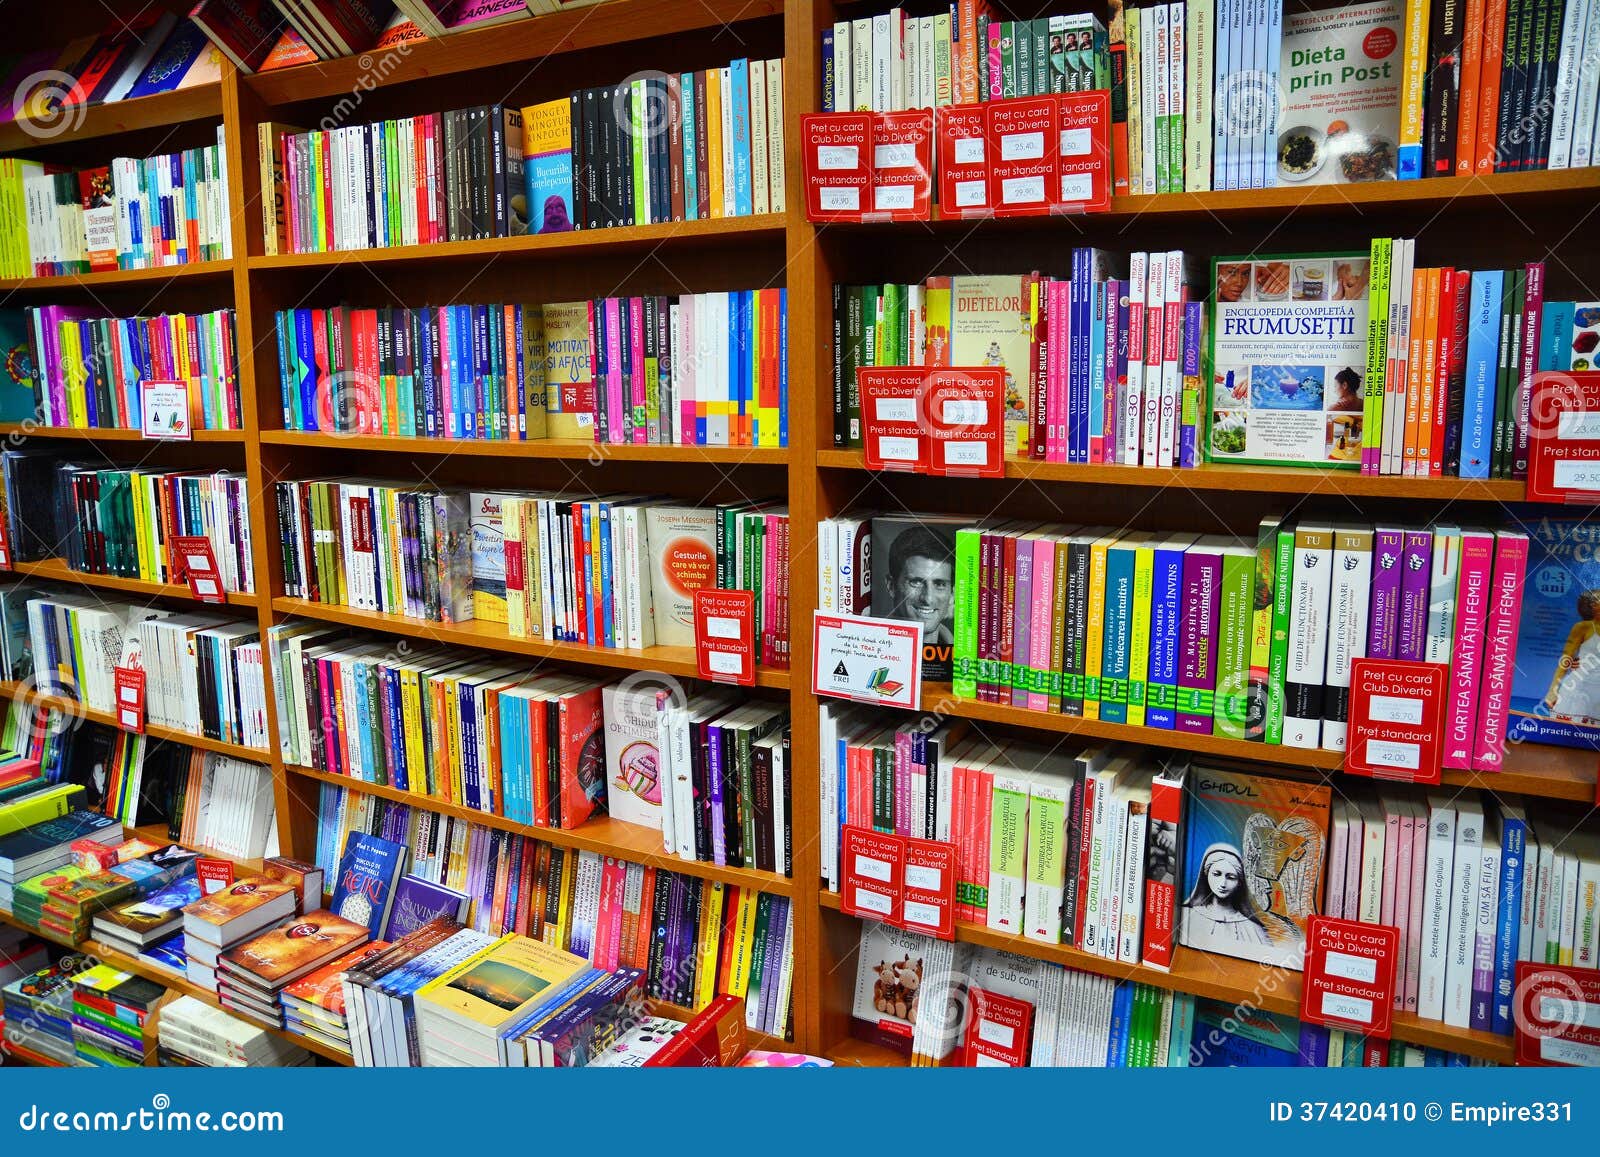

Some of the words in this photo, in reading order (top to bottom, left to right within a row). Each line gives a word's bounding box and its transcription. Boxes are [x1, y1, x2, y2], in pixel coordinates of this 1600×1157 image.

[1291, 46, 1345, 68] Dieta
[1290, 70, 1332, 93] prin
[1341, 62, 1392, 84] Post
[1028, 107, 1050, 117] card
[1074, 102, 1098, 112] card
[843, 123, 864, 132] card
[994, 122, 1015, 132] Club
[1018, 120, 1050, 130] Diverta
[1064, 116, 1098, 126] Diverta
[811, 135, 832, 144] Club
[834, 134, 864, 143] Diverta
[1012, 164, 1053, 176] standard
[829, 176, 866, 184] standard
[1482, 280, 1492, 307] Greene
[958, 296, 1021, 312] DIETELOR
[1225, 308, 1292, 316] ENCICLOPEDIA
[1294, 306, 1346, 316] COMPLETĂ
[1368, 320, 1377, 374] Personalizate
[1377, 319, 1387, 374] Personalizate
[1094, 353, 1104, 390] Pilates
[972, 378, 994, 386] card
[1519, 426, 1528, 449] GHIDUL
[1526, 310, 1536, 360] ALIMENTARE
[868, 388, 890, 396] Club
[961, 389, 994, 398] Diverta
[1474, 411, 1482, 424] de
[1472, 436, 1480, 449] Cu
[1304, 536, 1320, 546] TU
[1344, 537, 1361, 548] TU
[1382, 535, 1398, 546] TU
[1410, 536, 1427, 547] TU
[674, 550, 707, 560] Gesturile
[672, 561, 688, 569] care
[676, 570, 706, 579] schimba
[1540, 582, 1565, 594] ani
[1167, 610, 1176, 636] poate
[1188, 598, 1198, 656] MAOSHING
[1114, 620, 1125, 674] Vindecarea
[1164, 638, 1174, 678] Cancerul
[1196, 637, 1206, 679] Secretele
[1454, 692, 1469, 741] CARTEA
[1466, 570, 1482, 614] FEMEII
[1484, 694, 1500, 744] CARTEA
[1500, 572, 1517, 616] FEMEII
[1186, 660, 1194, 678] DR.
[1388, 673, 1404, 681] cu
[1406, 673, 1433, 684] card
[1362, 682, 1389, 692] Club
[1392, 685, 1432, 697] Diverta
[1383, 728, 1432, 742] standard
[1540, 726, 1572, 738] practic
[1081, 808, 1091, 852] Supernanny
[879, 842, 898, 852] card
[870, 849, 898, 862] Diverta
[1092, 837, 1102, 872] FERICIT
[864, 880, 898, 896] standard
[1480, 902, 1490, 925] CUM
[1344, 932, 1358, 940] cu
[1360, 934, 1386, 946] card
[1430, 928, 1438, 958] Secretele
[1320, 938, 1346, 950] Club
[1348, 943, 1386, 958] Diverta
[1456, 934, 1466, 966] Secretele
[1476, 934, 1494, 971] ghid
[986, 966, 998, 976] de
[1000, 968, 1016, 982] sub
[1336, 982, 1384, 1000] standard
